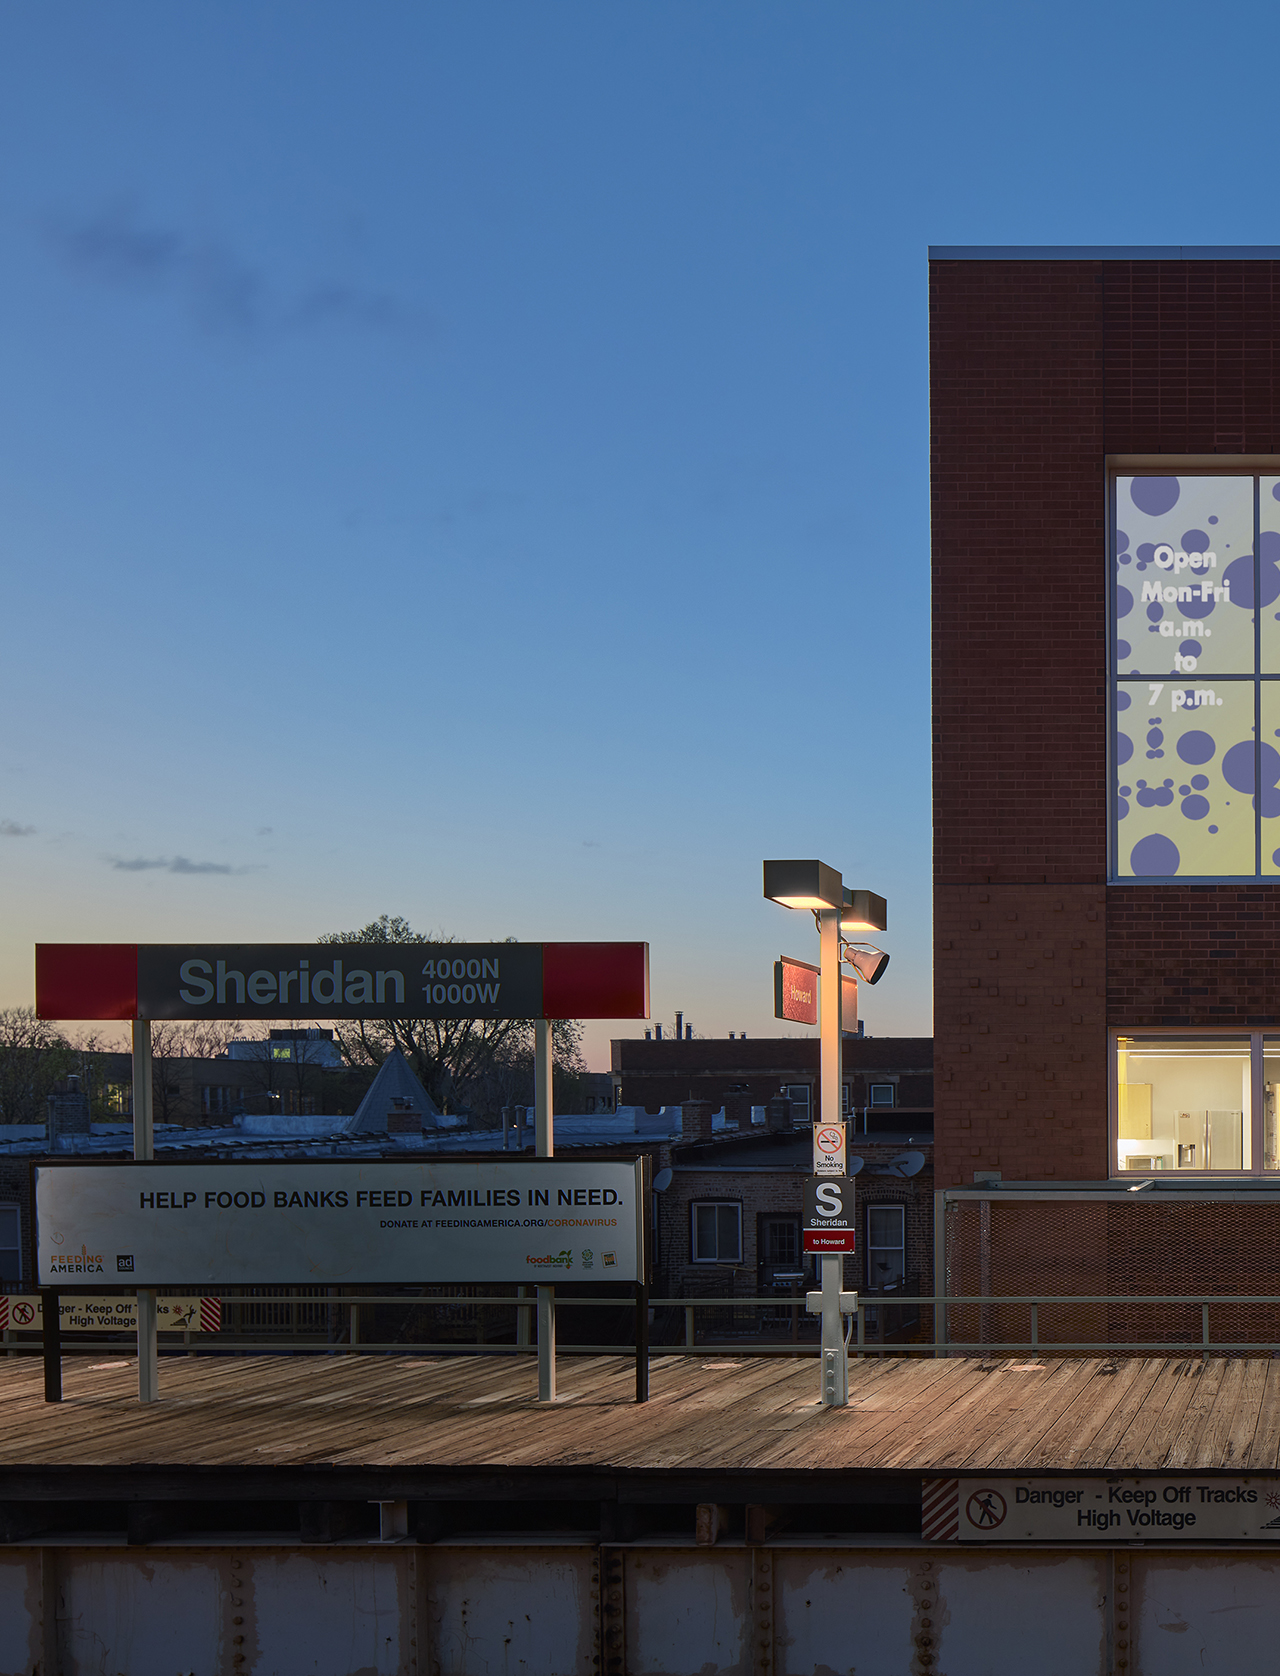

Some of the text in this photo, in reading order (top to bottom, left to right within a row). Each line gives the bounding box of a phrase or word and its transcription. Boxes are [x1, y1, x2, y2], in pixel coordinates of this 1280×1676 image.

[1154, 546, 1217, 574] Open
[1140, 579, 1230, 602] Mon-Fri
[1159, 618, 1212, 638] a.m.
[1174, 650, 1198, 672] to
[1148, 684, 1224, 712] 7 p.m.
[179, 958, 500, 1004] Sheridan 4000N
[422, 983, 500, 1004] 1000W
[790, 984, 812, 1004] Howard
[140, 1189, 623, 1208] HELP FOOD BANKS FEED FAMILIES IN NEED.
[816, 1182, 842, 1218] S
[436, 1218, 617, 1227] FEEDINGAMERICA.ORG/CORONAVIRUS
[810, 1218, 848, 1226] Sheridan
[50, 1265, 104, 1273] AMERICA
[51, 1255, 103, 1264] FEEDING
[118, 1256, 133, 1266] ad
[526, 1255, 573, 1264] foodbank
[38, 1304, 76, 1316] Dger
[85, 1304, 114, 1316] Keep
[116, 1304, 133, 1314] Off
[70, 1316, 137, 1327] High Voltage
[1015, 1486, 1084, 1508] Danger
[1108, 1486, 1158, 1508] Keep
[1162, 1485, 1192, 1504] Off
[1196, 1486, 1258, 1504] Tracks
[1077, 1509, 1197, 1530] High Voltage
